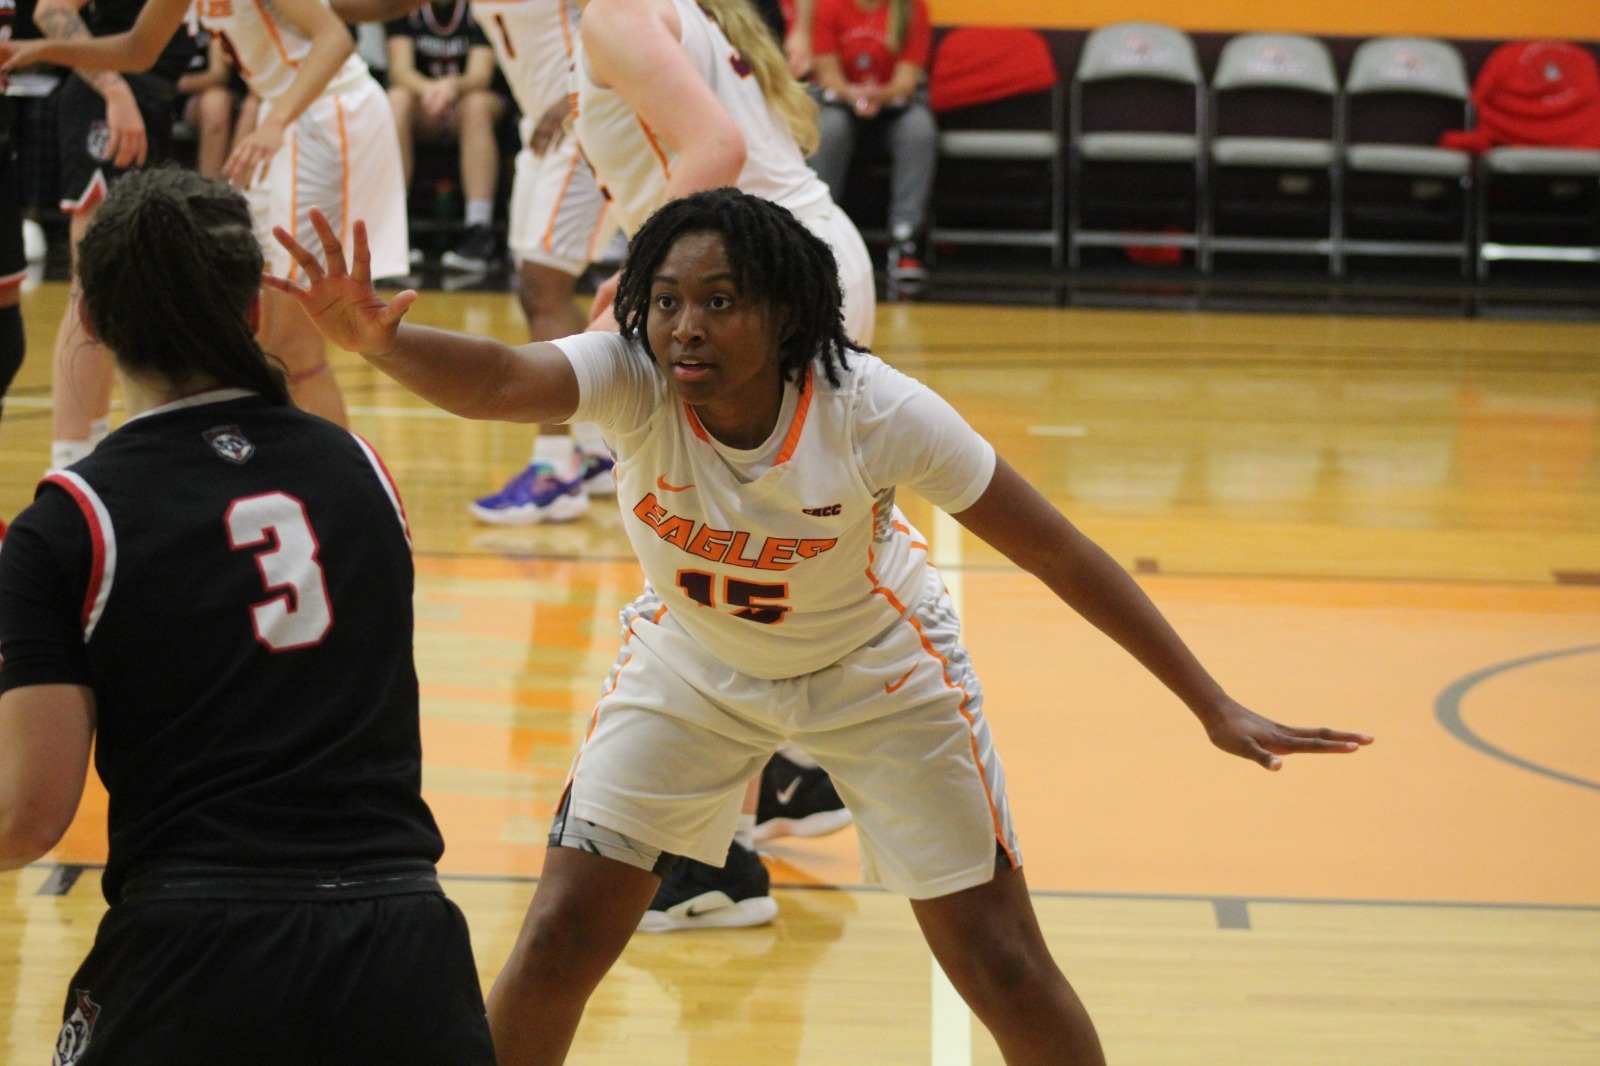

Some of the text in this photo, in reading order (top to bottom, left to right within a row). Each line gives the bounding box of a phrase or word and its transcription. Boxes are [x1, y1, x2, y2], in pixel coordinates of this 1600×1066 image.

[633, 492, 838, 571] EAGLES
[224, 490, 334, 653] 3
[675, 568, 793, 625] 15
